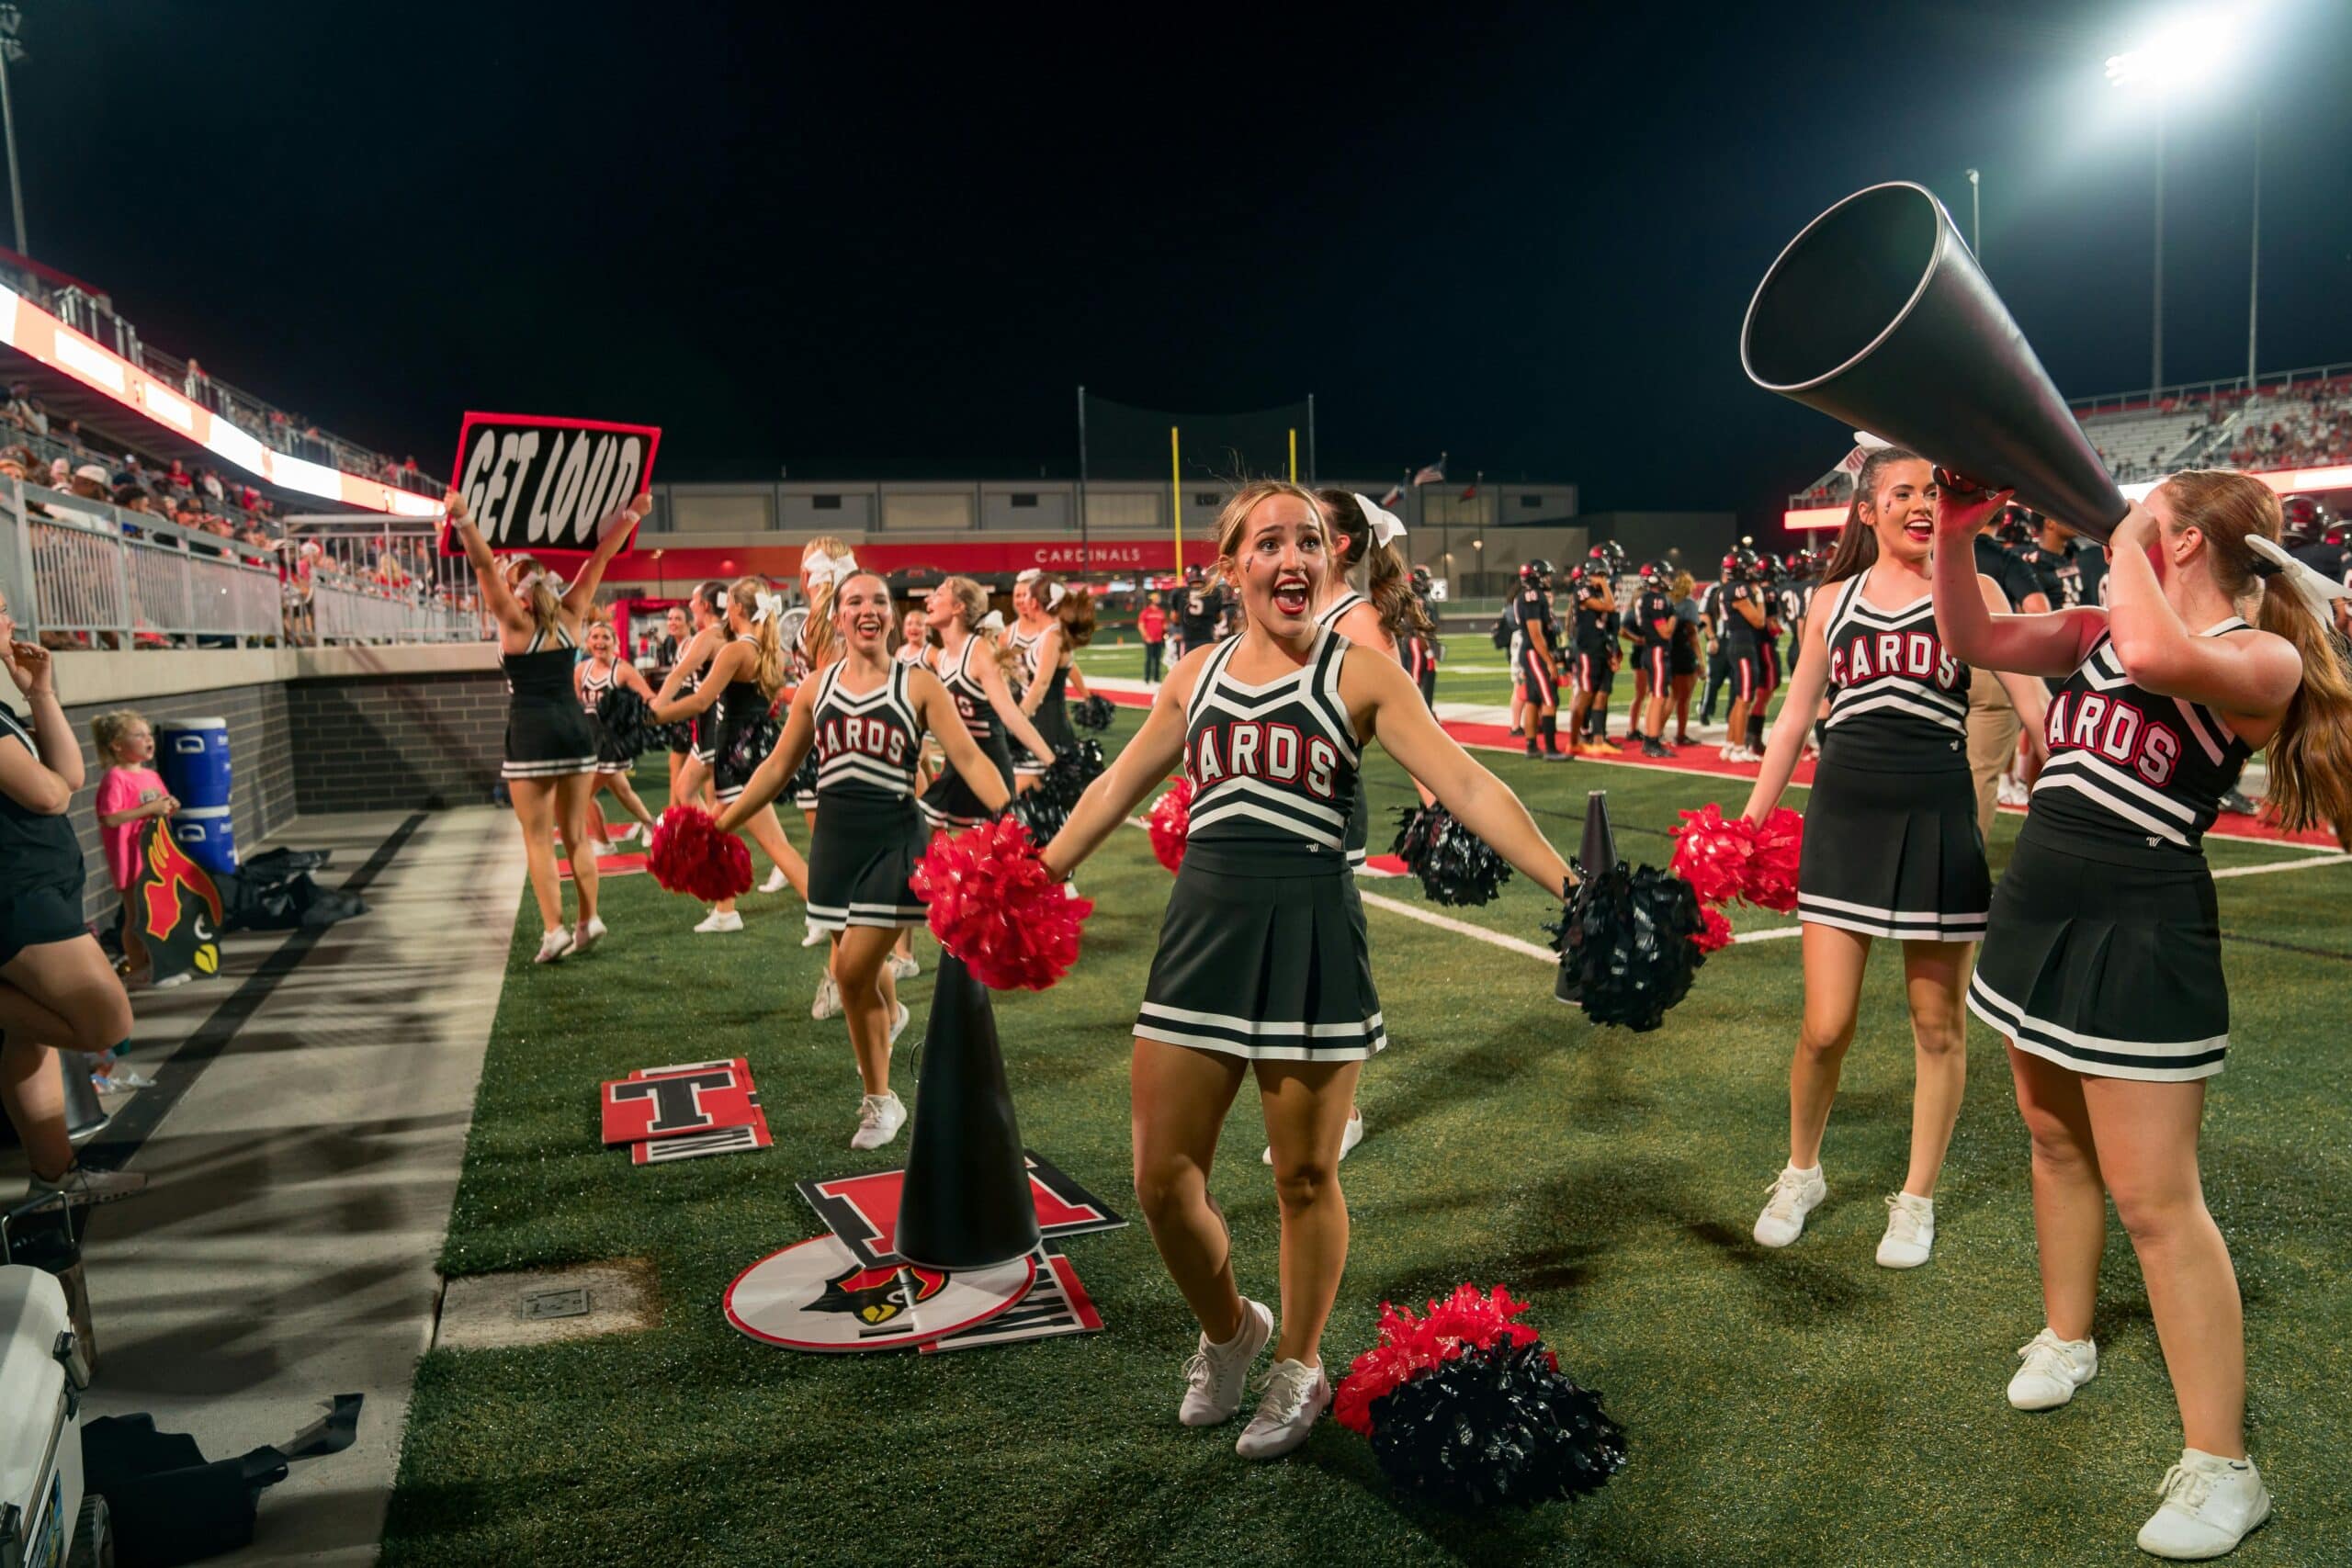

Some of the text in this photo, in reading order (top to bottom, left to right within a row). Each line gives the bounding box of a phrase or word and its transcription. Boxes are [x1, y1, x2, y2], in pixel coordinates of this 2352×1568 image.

[458, 429, 641, 546] GET LOUD
[1035, 547, 1140, 563] CARDINALS
[1189, 590, 1204, 615] 5
[1831, 632, 1958, 689] CARDS
[2045, 691, 2181, 787] ARDS
[611, 1070, 736, 1134] T
